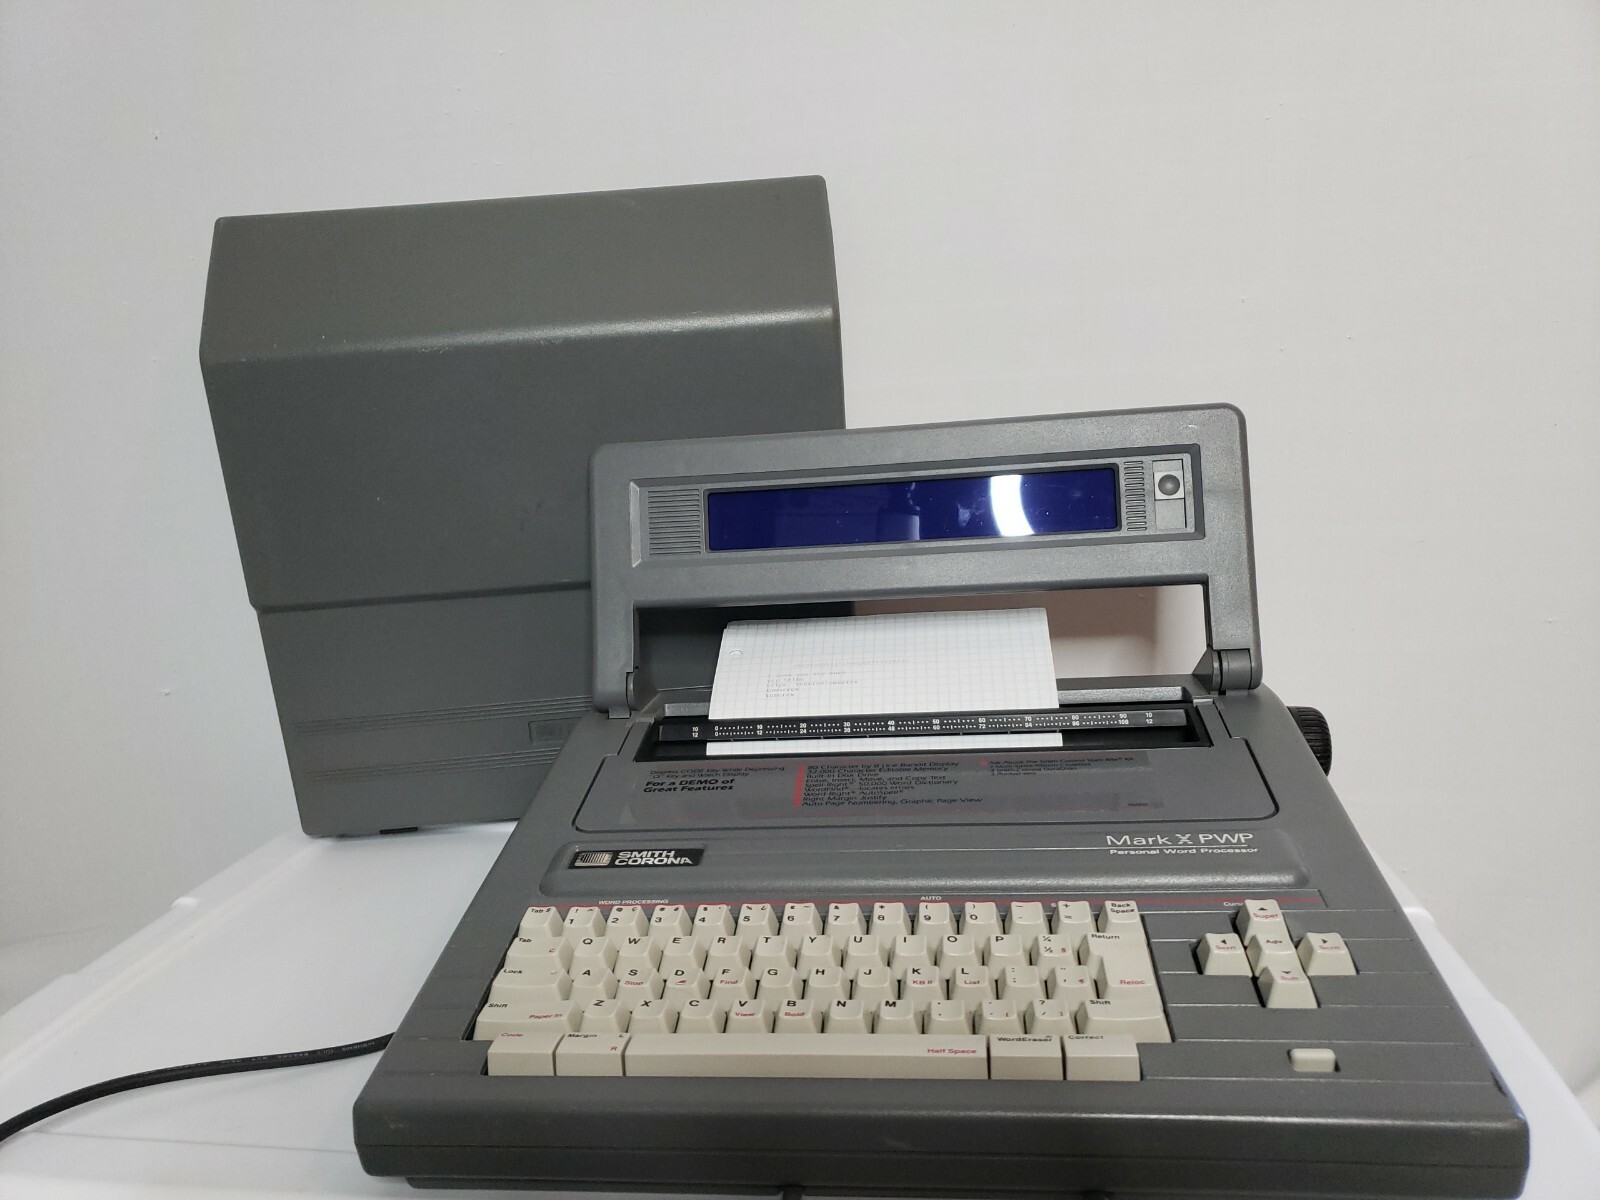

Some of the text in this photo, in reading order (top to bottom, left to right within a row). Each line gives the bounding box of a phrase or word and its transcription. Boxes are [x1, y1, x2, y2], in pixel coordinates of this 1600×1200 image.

[1106, 833, 1253, 845] Mark X PWP
[618, 850, 675, 858] SMITH
[614, 857, 693, 865] CORONA
